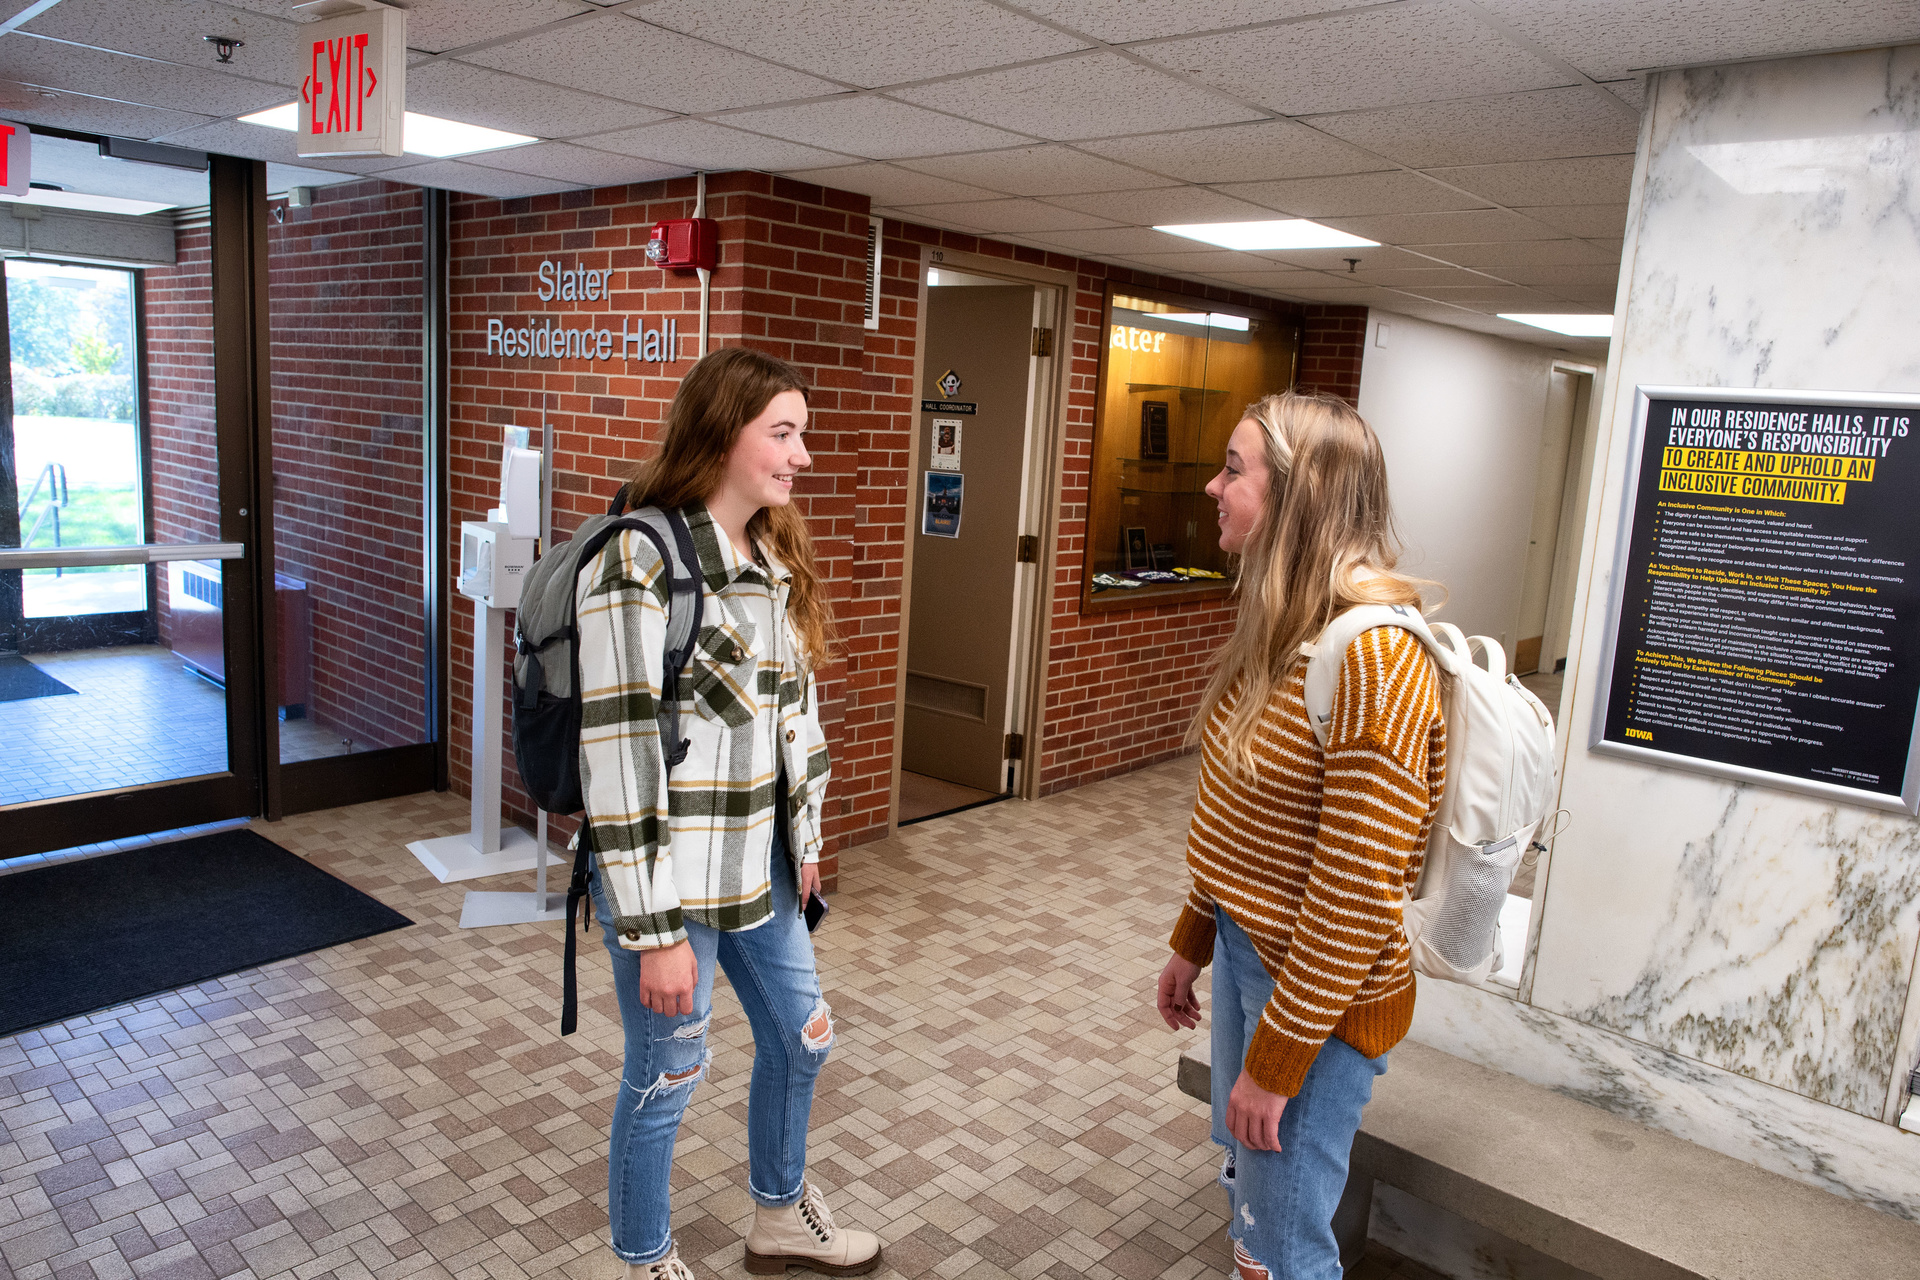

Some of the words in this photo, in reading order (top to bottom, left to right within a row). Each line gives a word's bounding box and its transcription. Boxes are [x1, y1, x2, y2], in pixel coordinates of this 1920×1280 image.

[312, 33, 369, 135] EXIT
[931, 251, 944, 262] 110
[538, 260, 613, 302] Slater
[487, 318, 613, 361] Residence
[623, 318, 677, 363] Hall
[939, 403, 973, 412] COORDINATOR
[1671, 408, 1687, 425] IN
[1690, 408, 1721, 427] OUR
[1724, 410, 1808, 431] RESIDENCE
[1811, 413, 1869, 437] HALLS,
[1872, 416, 1888, 435] IT
[1891, 417, 1910, 436] IS
[1668, 427, 1758, 449] EVERYONE'S
[1761, 432, 1891, 457] RESPONSIBILITY
[1665, 448, 1682, 465] TO
[1687, 450, 1740, 469] CREATE
[1744, 453, 1776, 472] AND
[1780, 455, 1842, 477] UPHOLD
[1847, 460, 1871, 478] AN
[1663, 471, 1737, 493] INCLUSIVE
[1742, 477, 1842, 501] COMMUNITY.
[1696, 504, 1733, 513] Community
[1659, 543, 1686, 551] recognized
[1778, 530, 1804, 538] equitable
[1647, 568, 1691, 579] Responsibility
[1699, 574, 1715, 582] Help
[1715, 576, 1739, 585] Uphold
[1749, 580, 1778, 588] Inclusive
[1779, 584, 1819, 594] Community
[1819, 588, 1830, 596] by:
[1671, 564, 1694, 572] Choose
[1703, 568, 1727, 577] Reside,
[1802, 579, 1830, 589] Spaces,
[1635, 655, 1659, 665] Actively
[1660, 659, 1682, 668] Upheld
[1708, 667, 1735, 676] Member
[1755, 674, 1796, 686] Community:
[1645, 650, 1669, 659] Achieve
[1670, 654, 1685, 662] This,
[1697, 658, 1720, 667] Believe
[1733, 664, 1764, 674] Following
[1765, 669, 1787, 677] Pieces
[1788, 672, 1813, 681] Should
[1639, 683, 1664, 692] Recognize
[1690, 683, 1710, 691] yourself
[1625, 727, 1653, 740] IOWA
